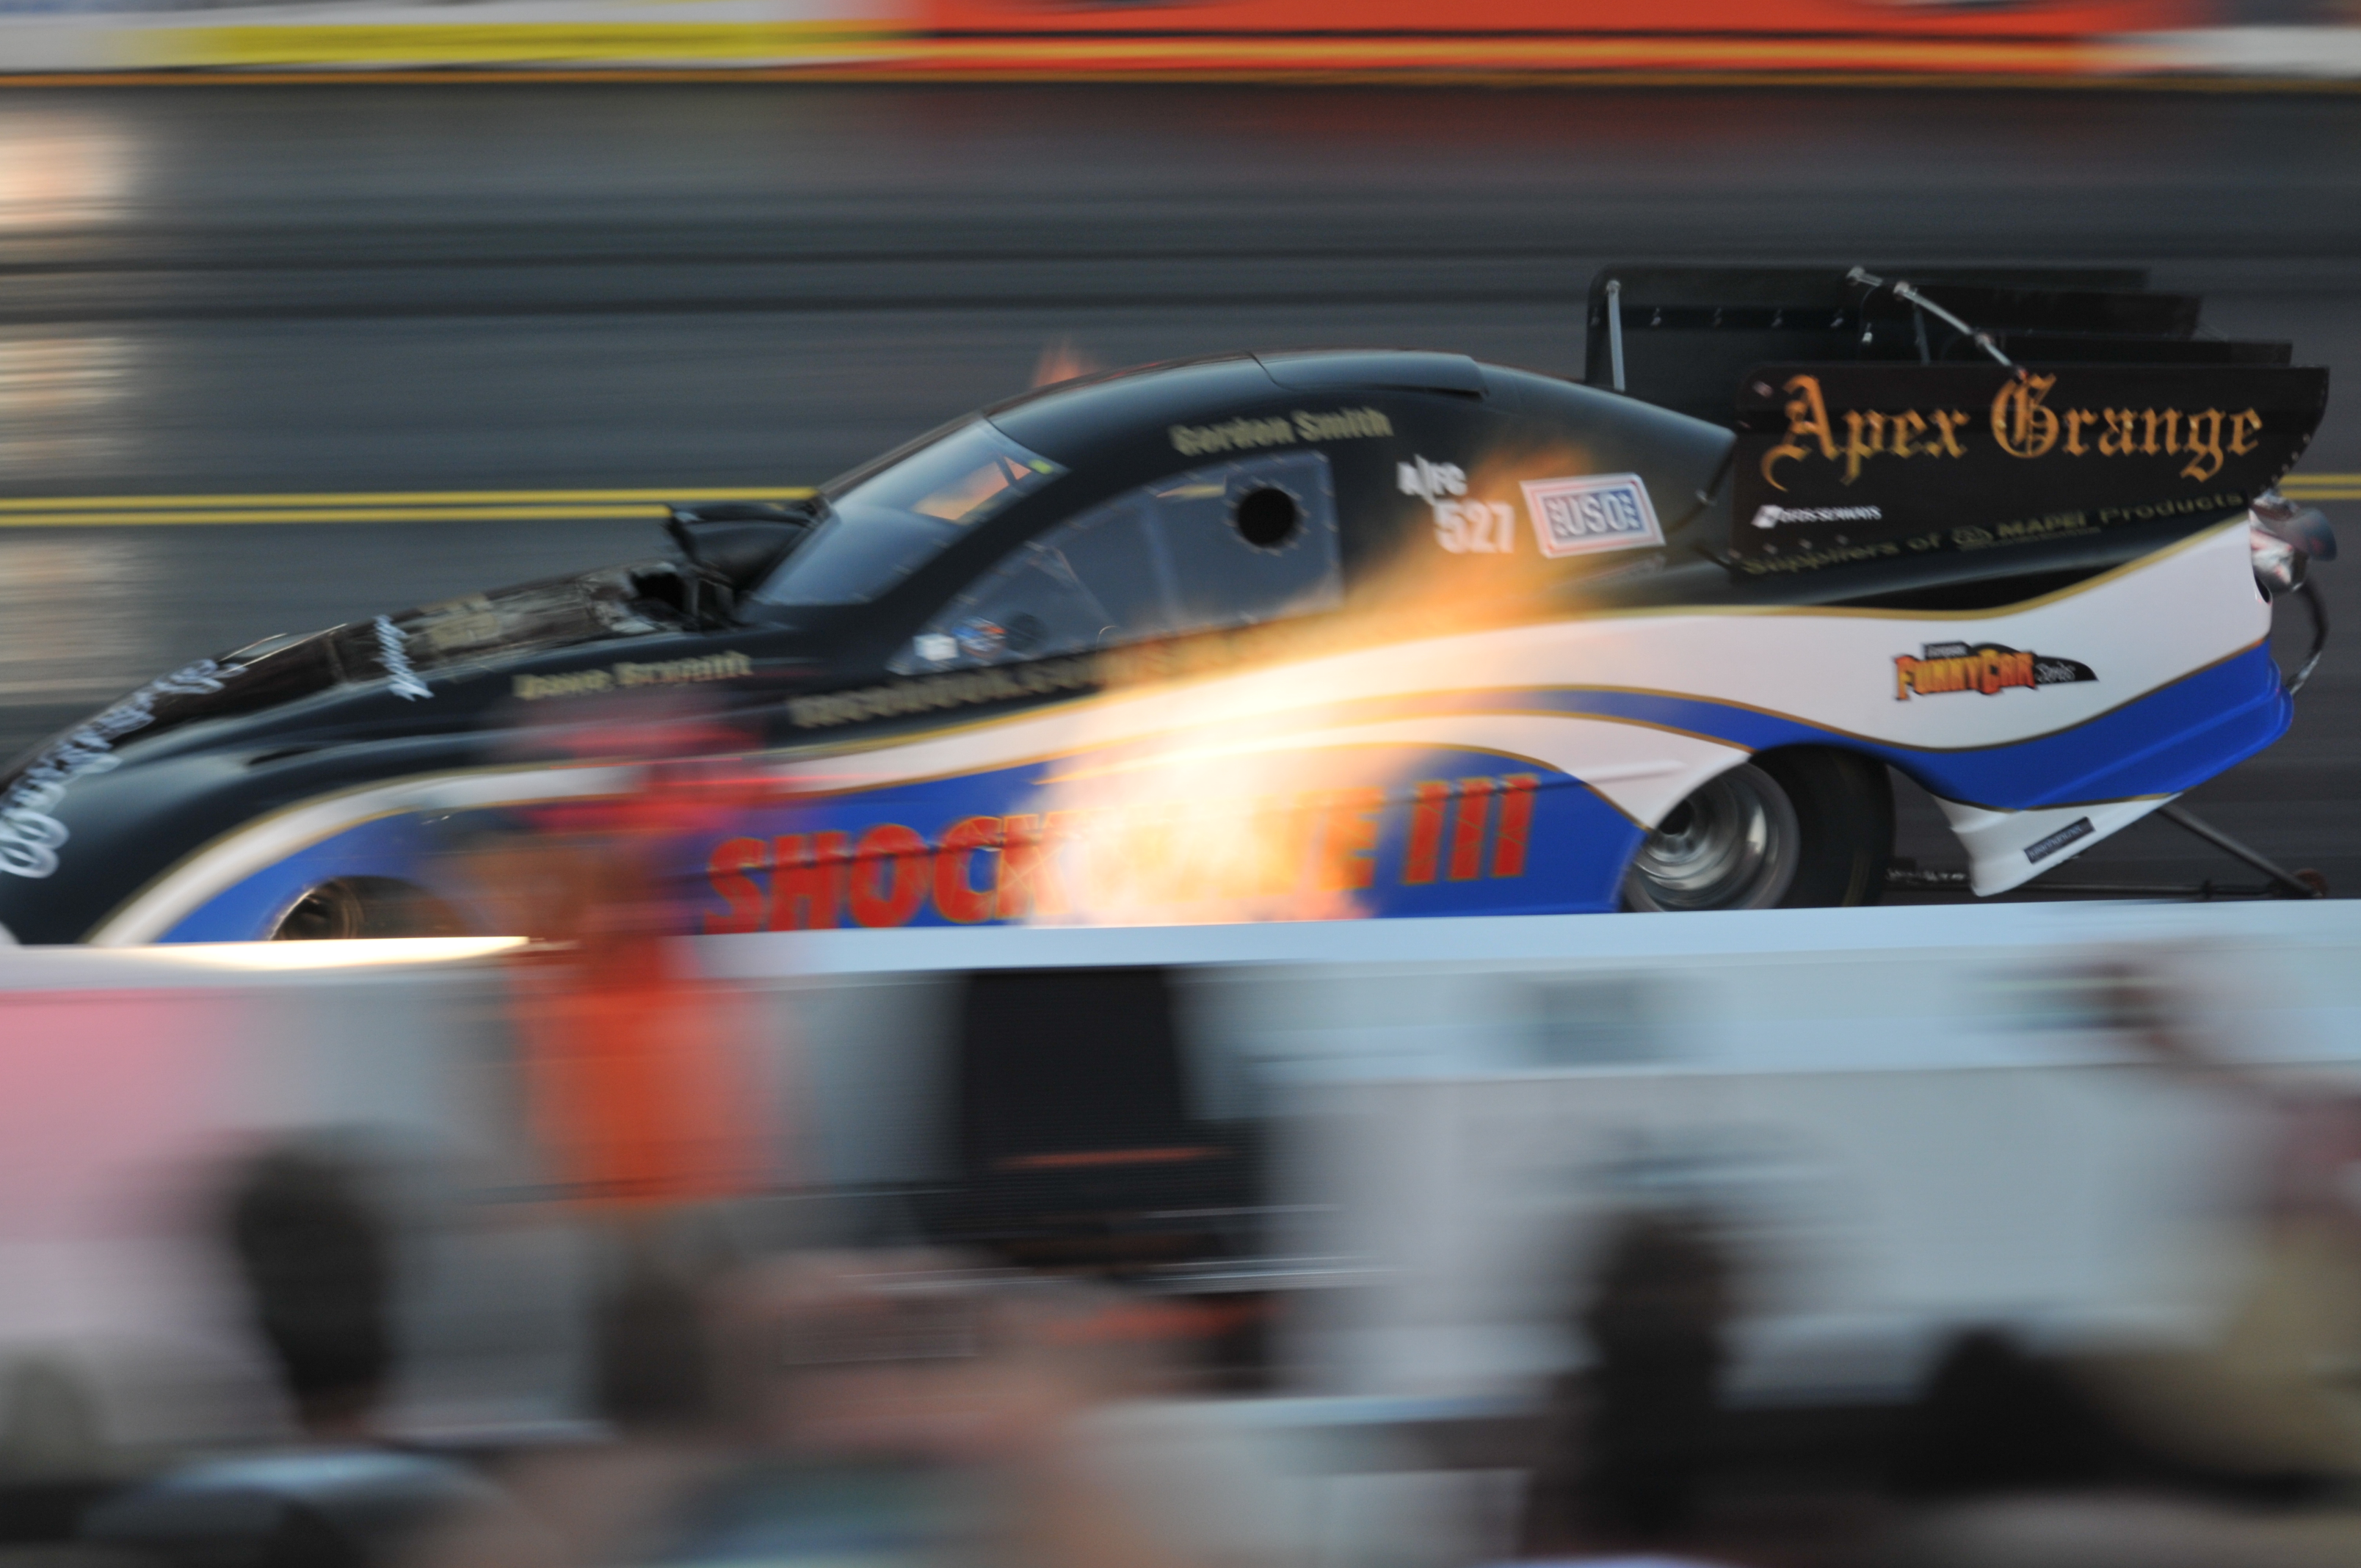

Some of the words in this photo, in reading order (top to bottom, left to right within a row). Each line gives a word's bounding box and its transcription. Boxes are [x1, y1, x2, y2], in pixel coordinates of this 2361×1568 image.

[1289, 405, 1393, 440] Smith
[1760, 374, 1970, 491] Apex
[1990, 372, 2263, 482] Grange
[1434, 498, 1515, 553] 527
[1556, 493, 1629, 536] USO
[1907, 532, 1942, 551] of
[1995, 512, 2087, 539] MAPEI
[2099, 492, 2243, 524] Products
[703, 785, 1386, 934] SHOCKE
